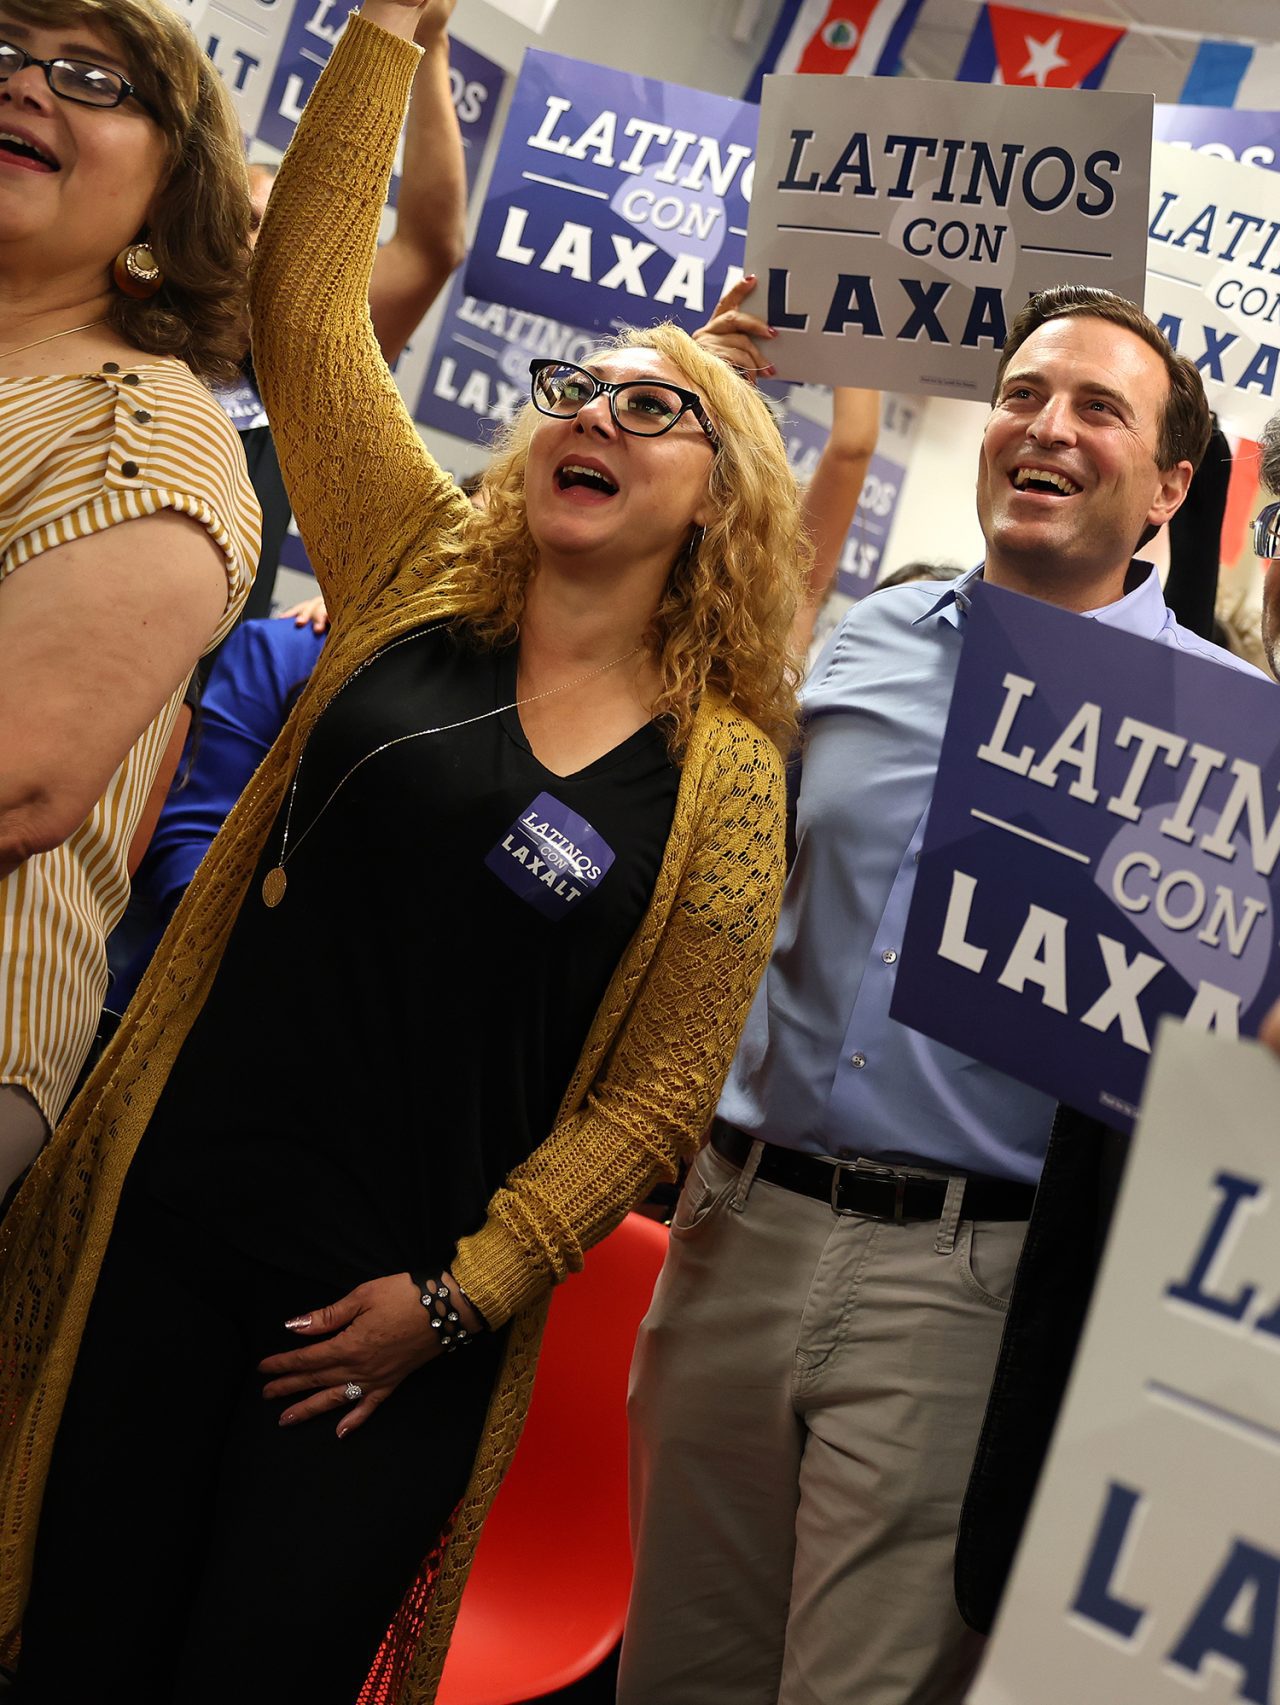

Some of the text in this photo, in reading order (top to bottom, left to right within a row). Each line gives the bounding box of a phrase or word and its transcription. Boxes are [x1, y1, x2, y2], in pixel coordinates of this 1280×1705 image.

[527, 95, 756, 202] LATIN
[777, 128, 1122, 216] LATINOS
[621, 188, 721, 242] CON
[902, 217, 1008, 264] CON
[496, 205, 745, 314] LAXA
[456, 296, 597, 366] LATINO
[766, 268, 1006, 351] LAXA
[432, 354, 522, 424] LAX
[501, 833, 582, 902] LAXALT
[522, 811, 602, 881] LATINOS
[540, 846, 568, 870] CON
[1111, 850, 1267, 958] CON
[937, 868, 1242, 1055] LAXA
